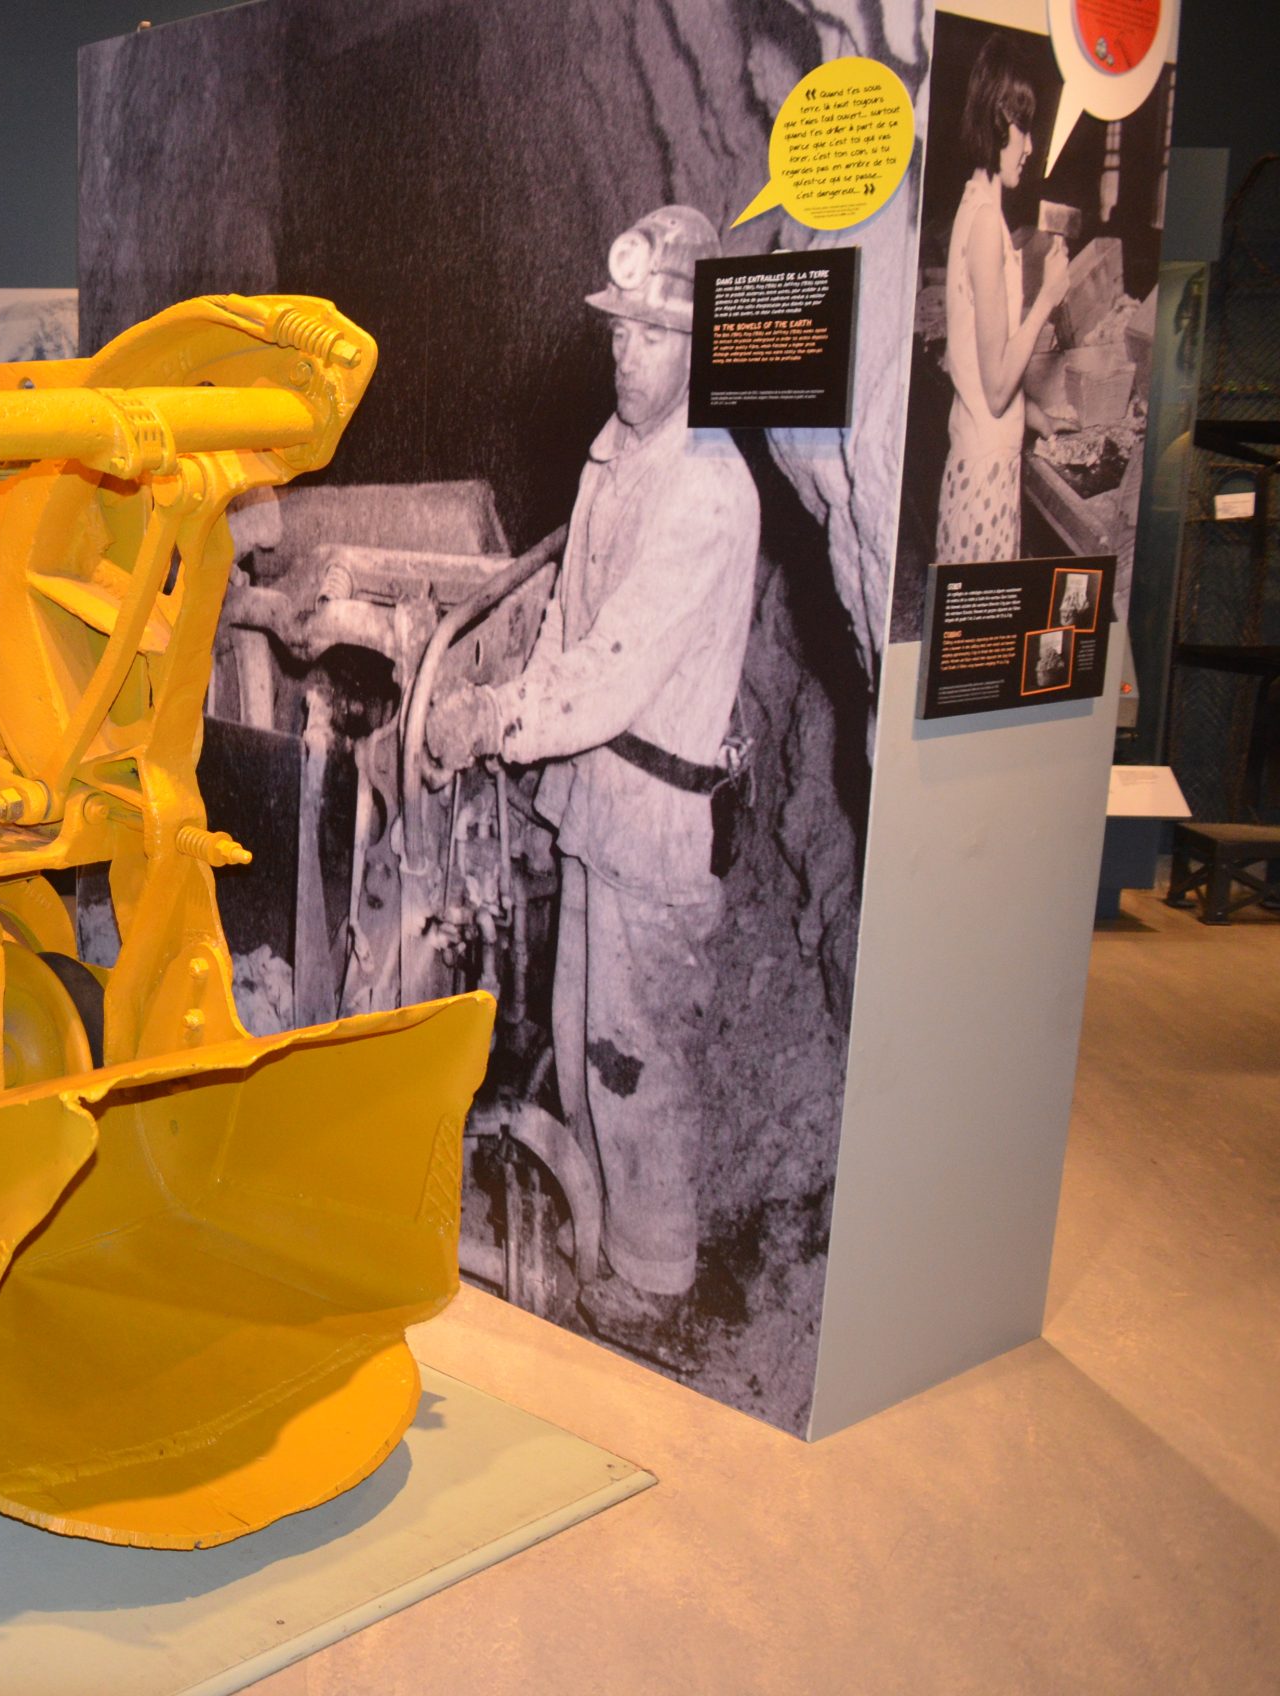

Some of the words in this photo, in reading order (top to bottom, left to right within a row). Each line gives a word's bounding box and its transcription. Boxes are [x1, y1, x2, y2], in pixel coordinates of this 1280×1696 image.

[820, 89, 844, 98] Quand
[863, 84, 882, 92] sous
[853, 96, 884, 108] toujours
[870, 106, 900, 117] surtout
[716, 276, 734, 286] DANS
[734, 275, 747, 285] LES
[748, 272, 785, 284] ENTRAILLES
[786, 272, 796, 281] DE
[797, 272, 808, 280] LA
[809, 269, 830, 279] TERRE
[722, 323, 735, 331] THE
[736, 321, 762, 331] BOWELS
[763, 320, 773, 329] OF
[774, 320, 788, 329] THE
[789, 318, 813, 328] EARTH
